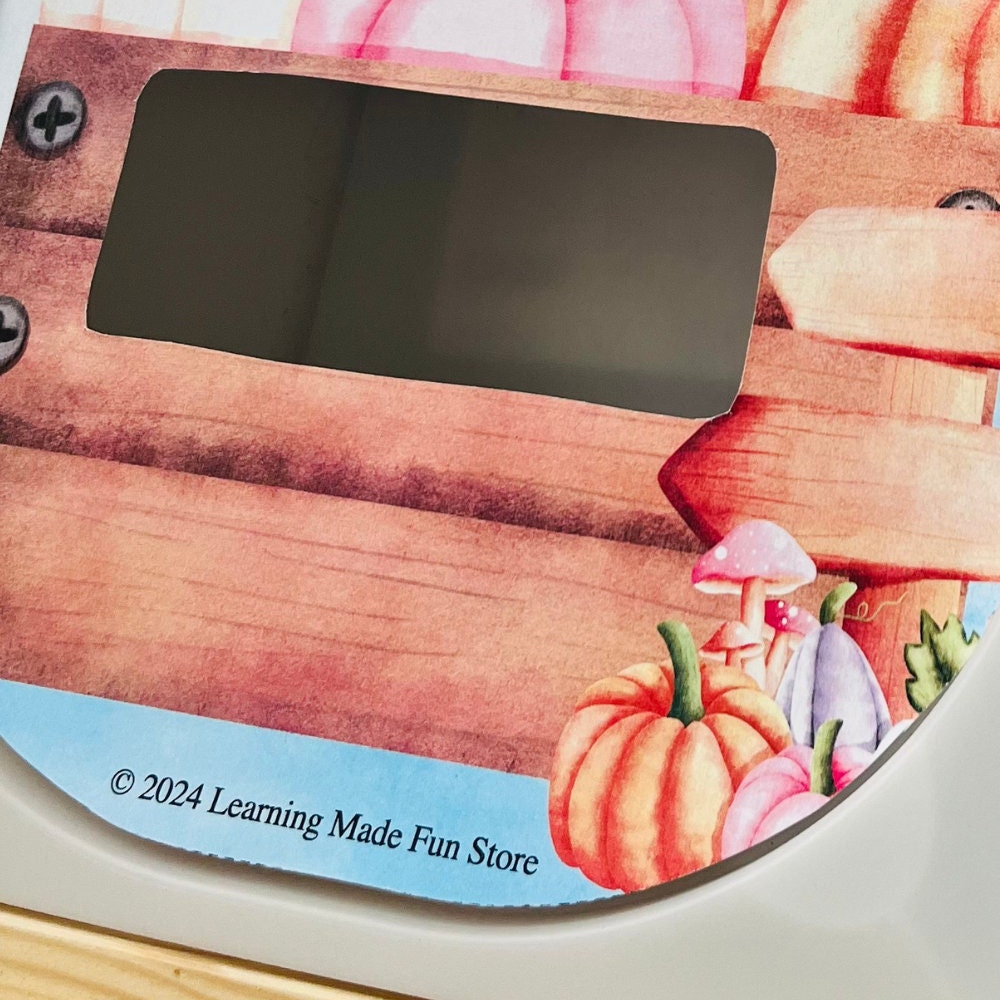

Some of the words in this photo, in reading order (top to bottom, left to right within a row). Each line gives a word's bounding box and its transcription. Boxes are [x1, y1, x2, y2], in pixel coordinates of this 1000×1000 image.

[110, 768, 136, 795] ©
[138, 774, 204, 810] 2024
[207, 786, 324, 841] Learning
[327, 809, 403, 849] Made
[407, 824, 460, 861] Fun
[466, 836, 539, 876] Store
